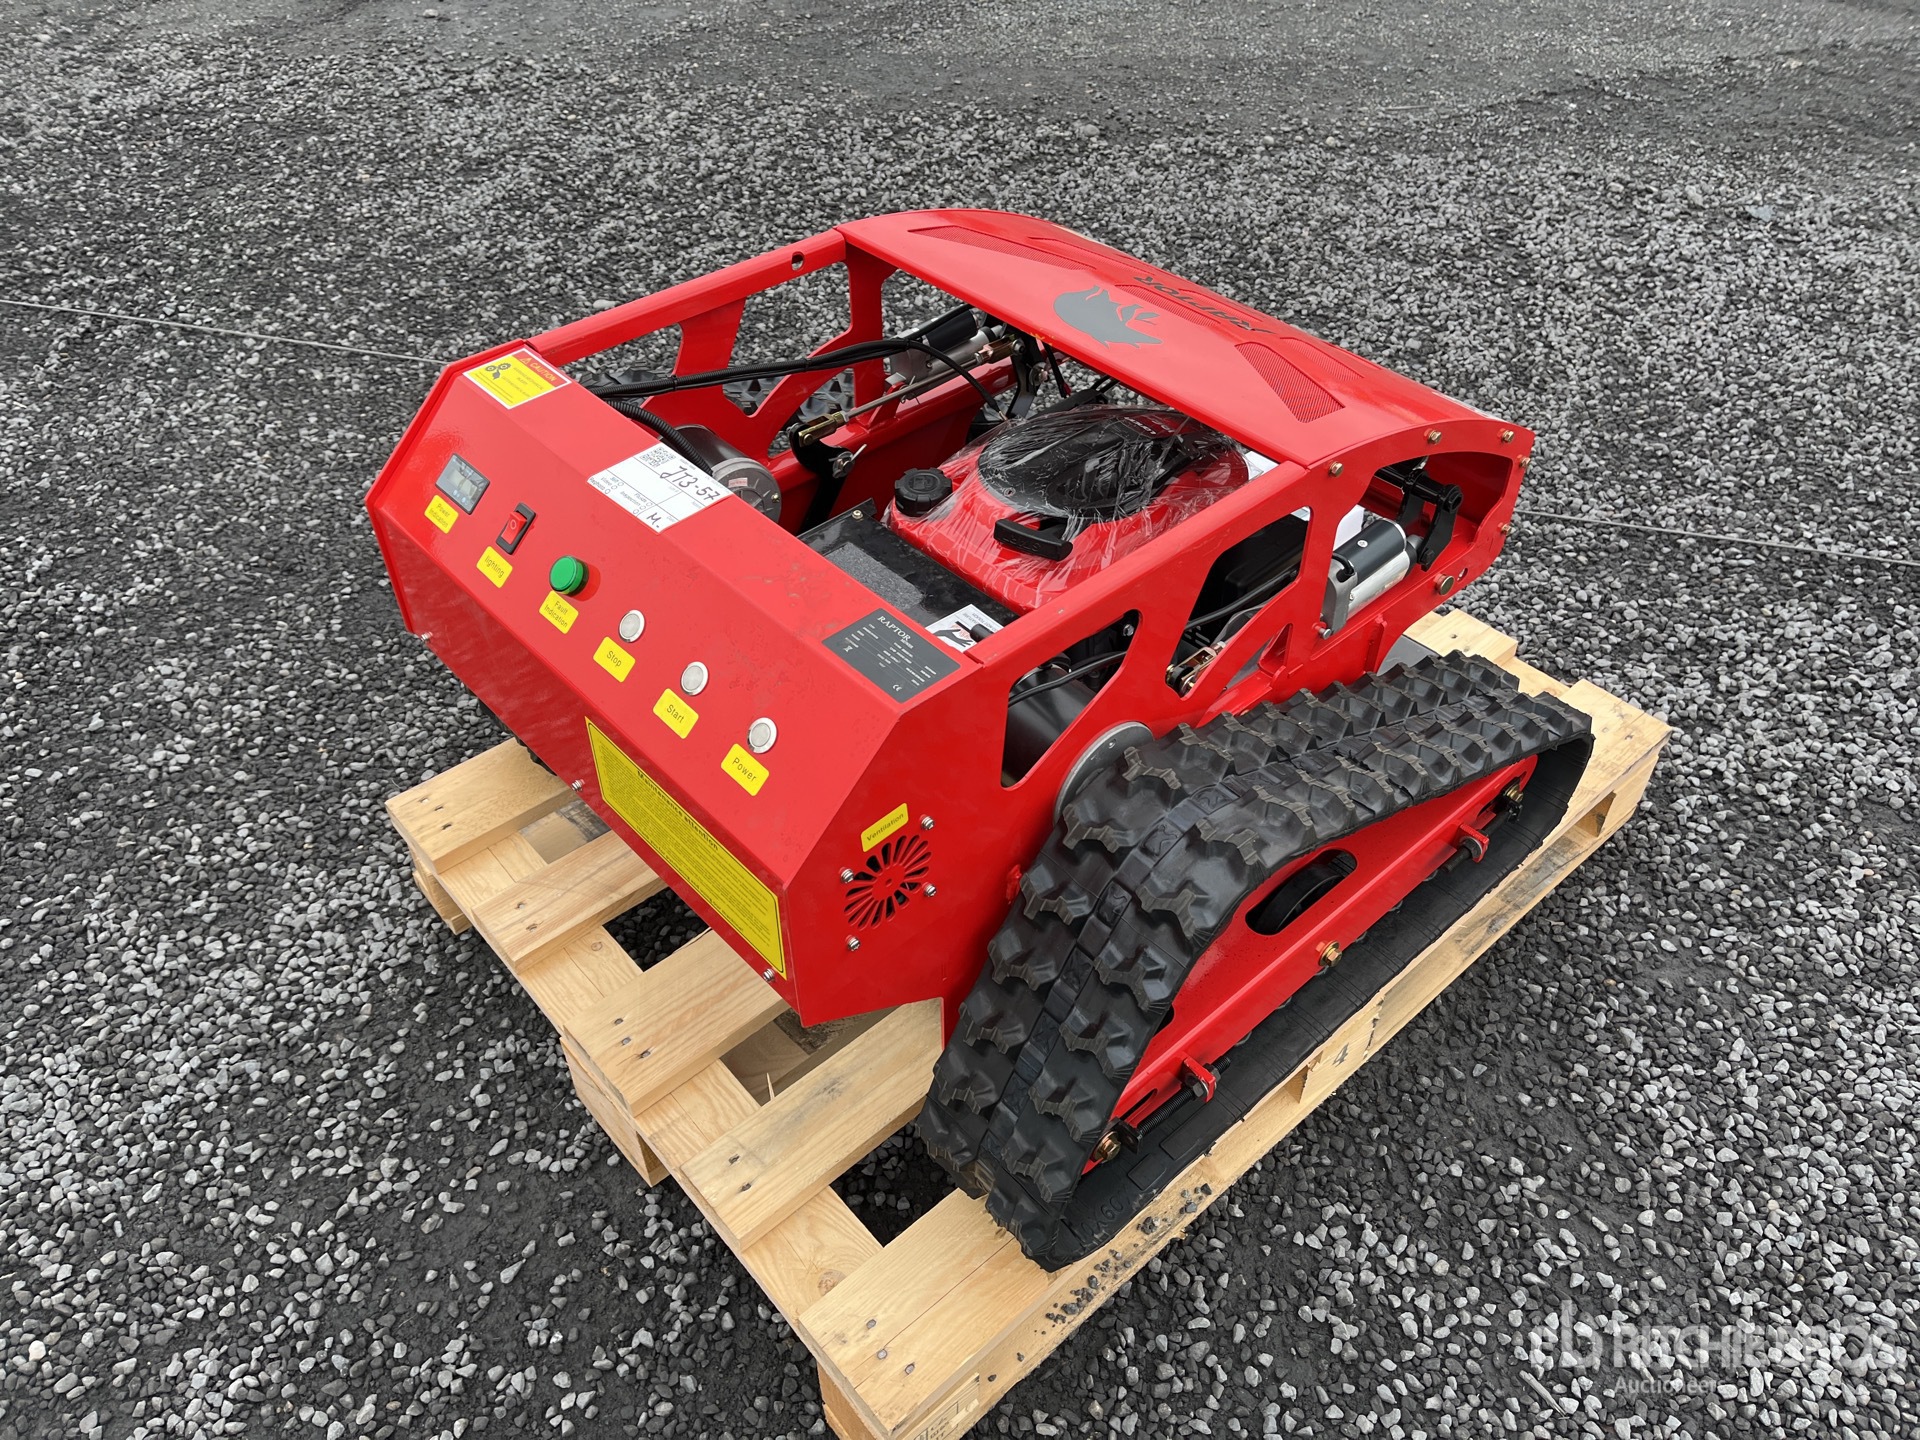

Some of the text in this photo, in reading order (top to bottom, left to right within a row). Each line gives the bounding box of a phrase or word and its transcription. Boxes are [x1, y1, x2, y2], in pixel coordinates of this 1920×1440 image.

[1133, 276, 1277, 334] RAPTOR
[530, 362, 557, 382] CAUTION
[428, 508, 449, 529] Indication
[435, 502, 451, 518] Power
[484, 556, 505, 578] lighting
[544, 604, 568, 628] Indication
[554, 600, 569, 616] Fault
[877, 616, 911, 641] RAPTOR
[606, 650, 622, 668] Stop
[666, 704, 685, 724] Start
[732, 756, 757, 783] Power
[637, 770, 719, 851] Maintenance attention
[866, 813, 904, 841] Ventilation
